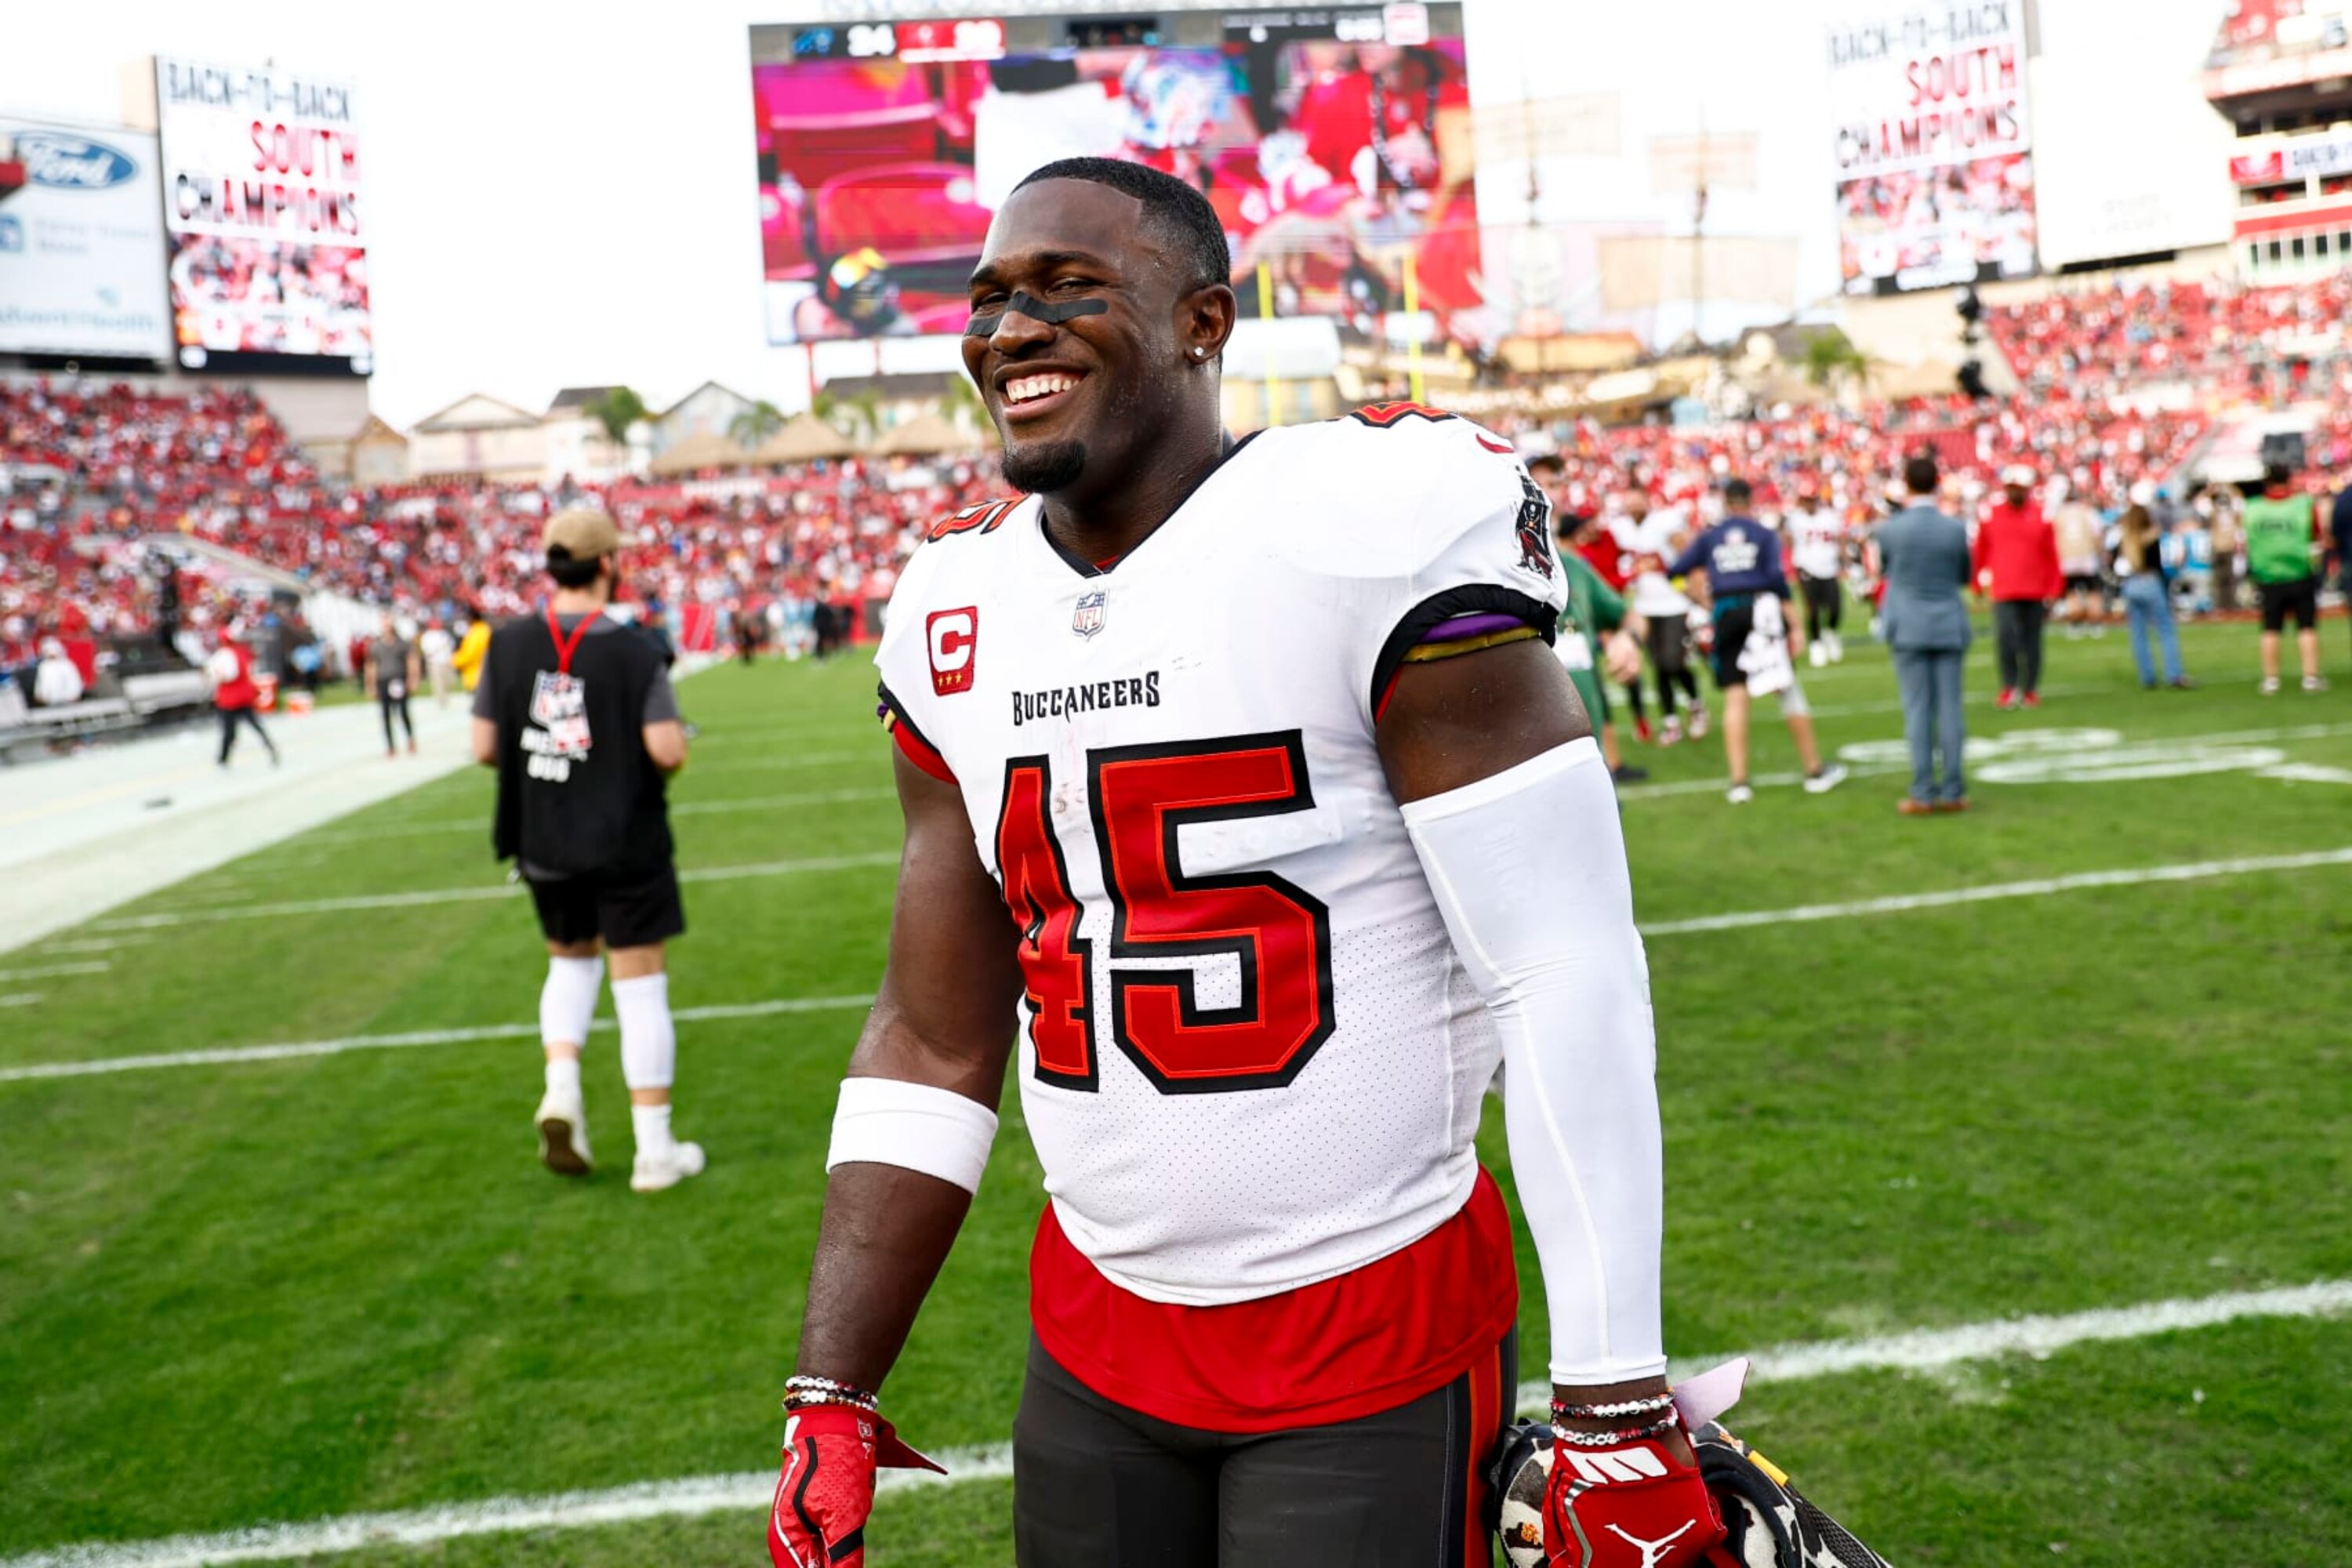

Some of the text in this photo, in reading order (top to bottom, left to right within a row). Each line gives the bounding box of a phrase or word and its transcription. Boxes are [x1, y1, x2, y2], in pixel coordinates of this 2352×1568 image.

[1907, 44, 2016, 106] SOUTH
[18, 138, 114, 185] Ford
[251, 121, 358, 180] SOUTH
[1838, 100, 2019, 169] CHAMPIONS
[177, 173, 359, 236] CHAMPIONS
[930, 613, 973, 672] C
[1075, 608, 1098, 628] NFL
[994, 728, 1336, 1096] 45
